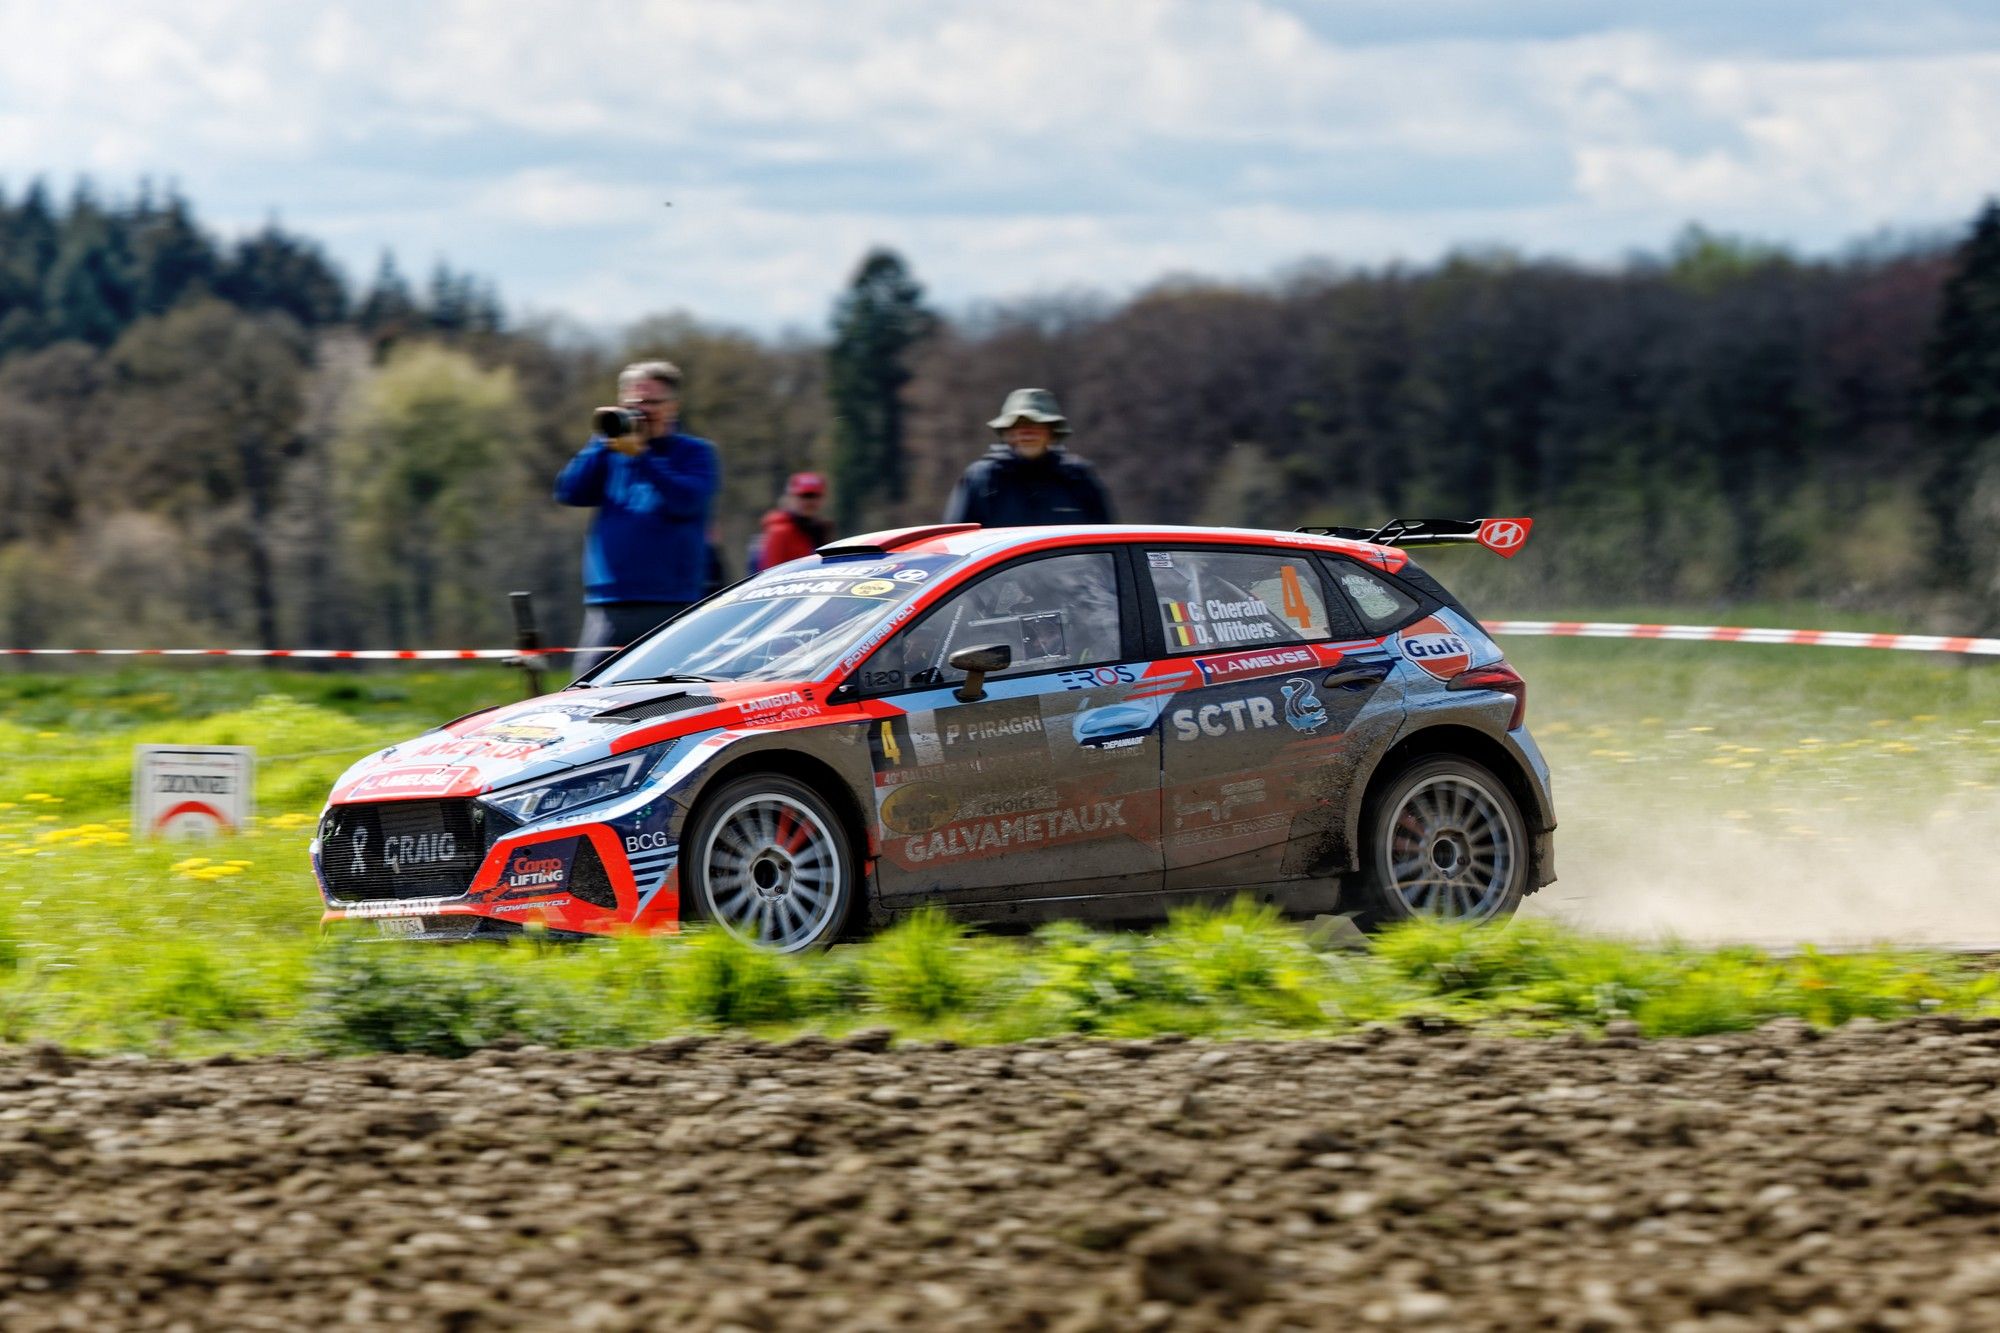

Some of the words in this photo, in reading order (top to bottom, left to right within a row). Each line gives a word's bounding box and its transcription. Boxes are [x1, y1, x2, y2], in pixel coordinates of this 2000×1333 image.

[1281, 565, 1311, 629] 4
[1187, 602, 1206, 622] C.
[1206, 597, 1268, 619] Cherain
[1195, 623, 1213, 644] D.
[1212, 620, 1275, 643] Withers
[1404, 638, 1464, 658] Gulf
[1058, 666, 1135, 690] EROS
[737, 691, 803, 714] LAMBDA
[744, 704, 820, 727] INSULATION
[968, 715, 1043, 740] PIRAGRI
[1173, 697, 1279, 741] SCTR
[881, 720, 901, 765] 4
[626, 831, 667, 852] BCG
[905, 799, 1126, 863] GALVAMETAUX
[513, 856, 562, 874] Cargo
[510, 868, 564, 887] LIFTING
